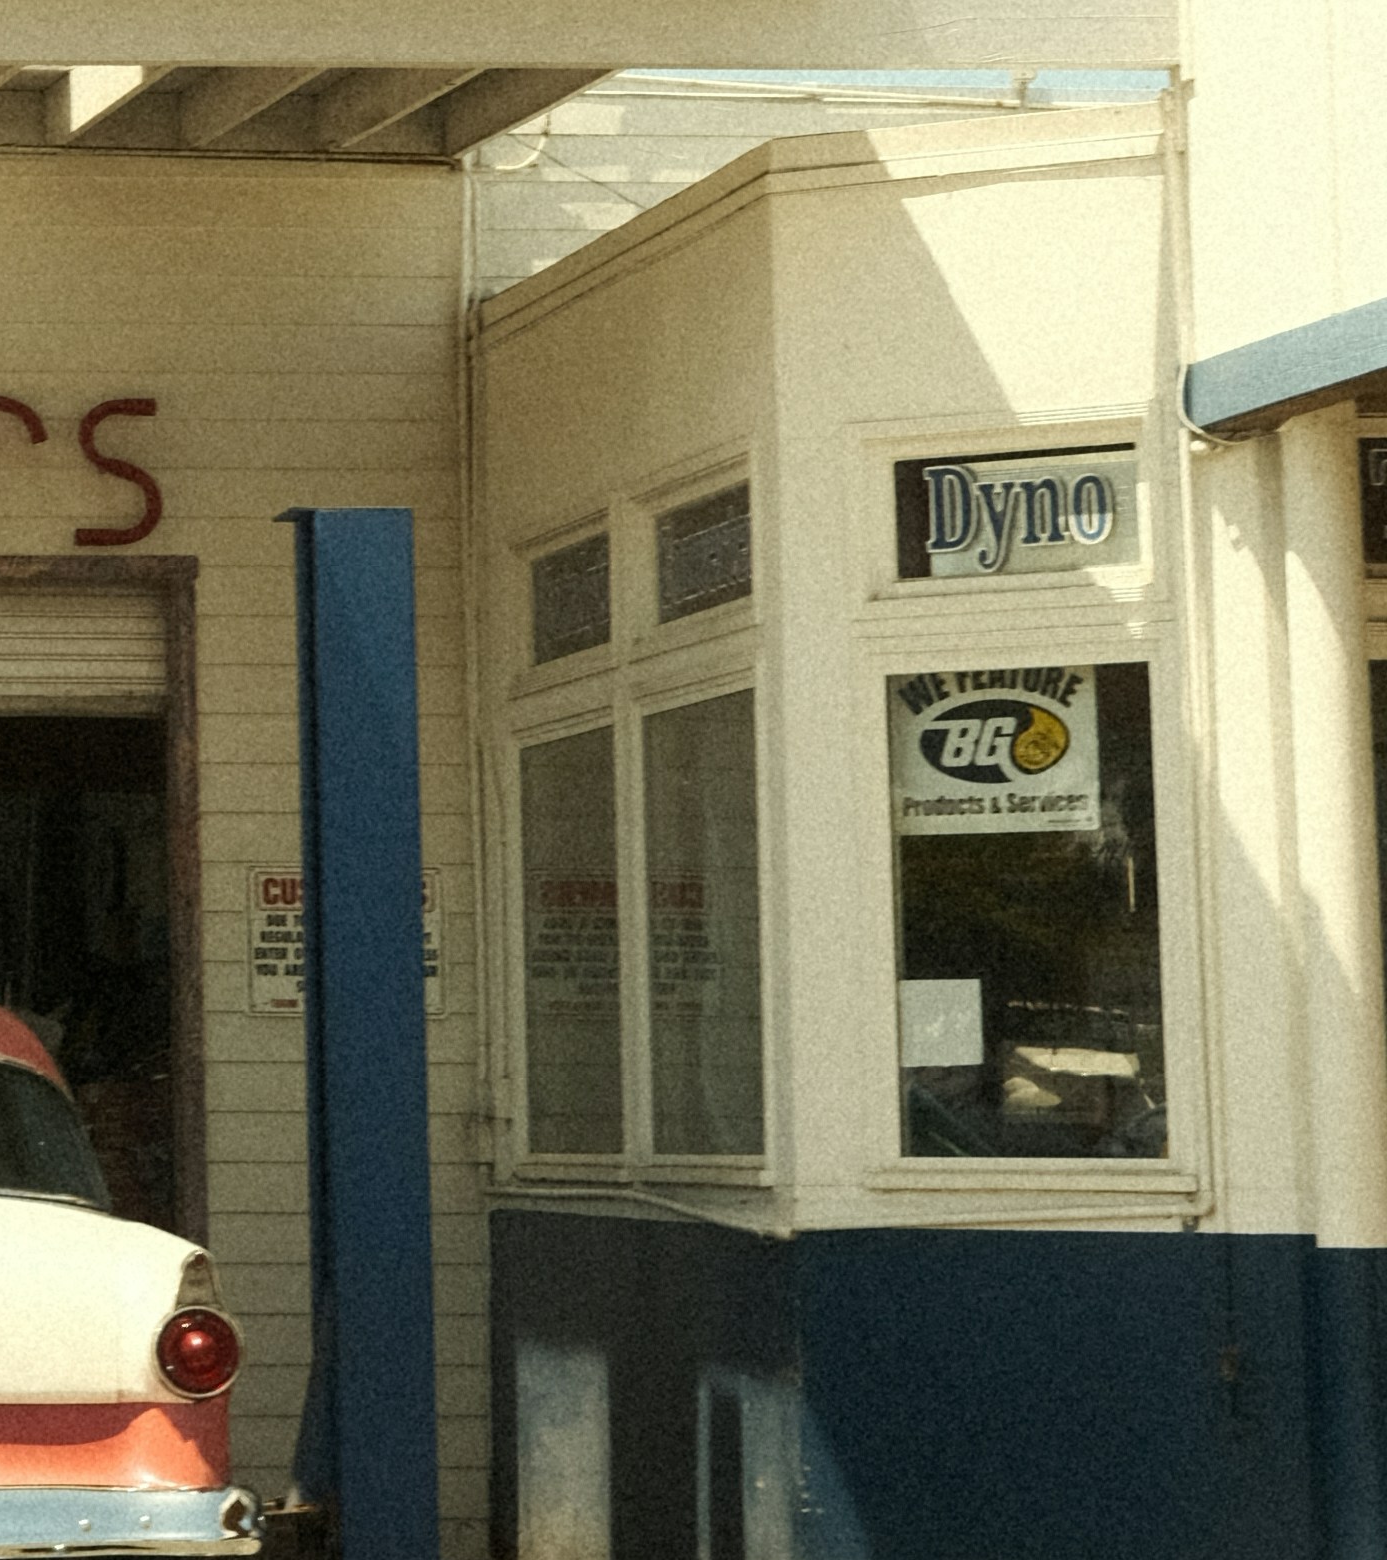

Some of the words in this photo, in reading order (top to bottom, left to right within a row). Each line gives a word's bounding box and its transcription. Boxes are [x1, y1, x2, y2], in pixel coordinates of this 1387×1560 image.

[923, 465, 1114, 573] Dyno
[898, 672, 950, 715] WE
[955, 666, 1084, 708] FEATURE
[935, 717, 1018, 768] BG
[902, 795, 985, 817] Products
[1006, 792, 1089, 813] Services
